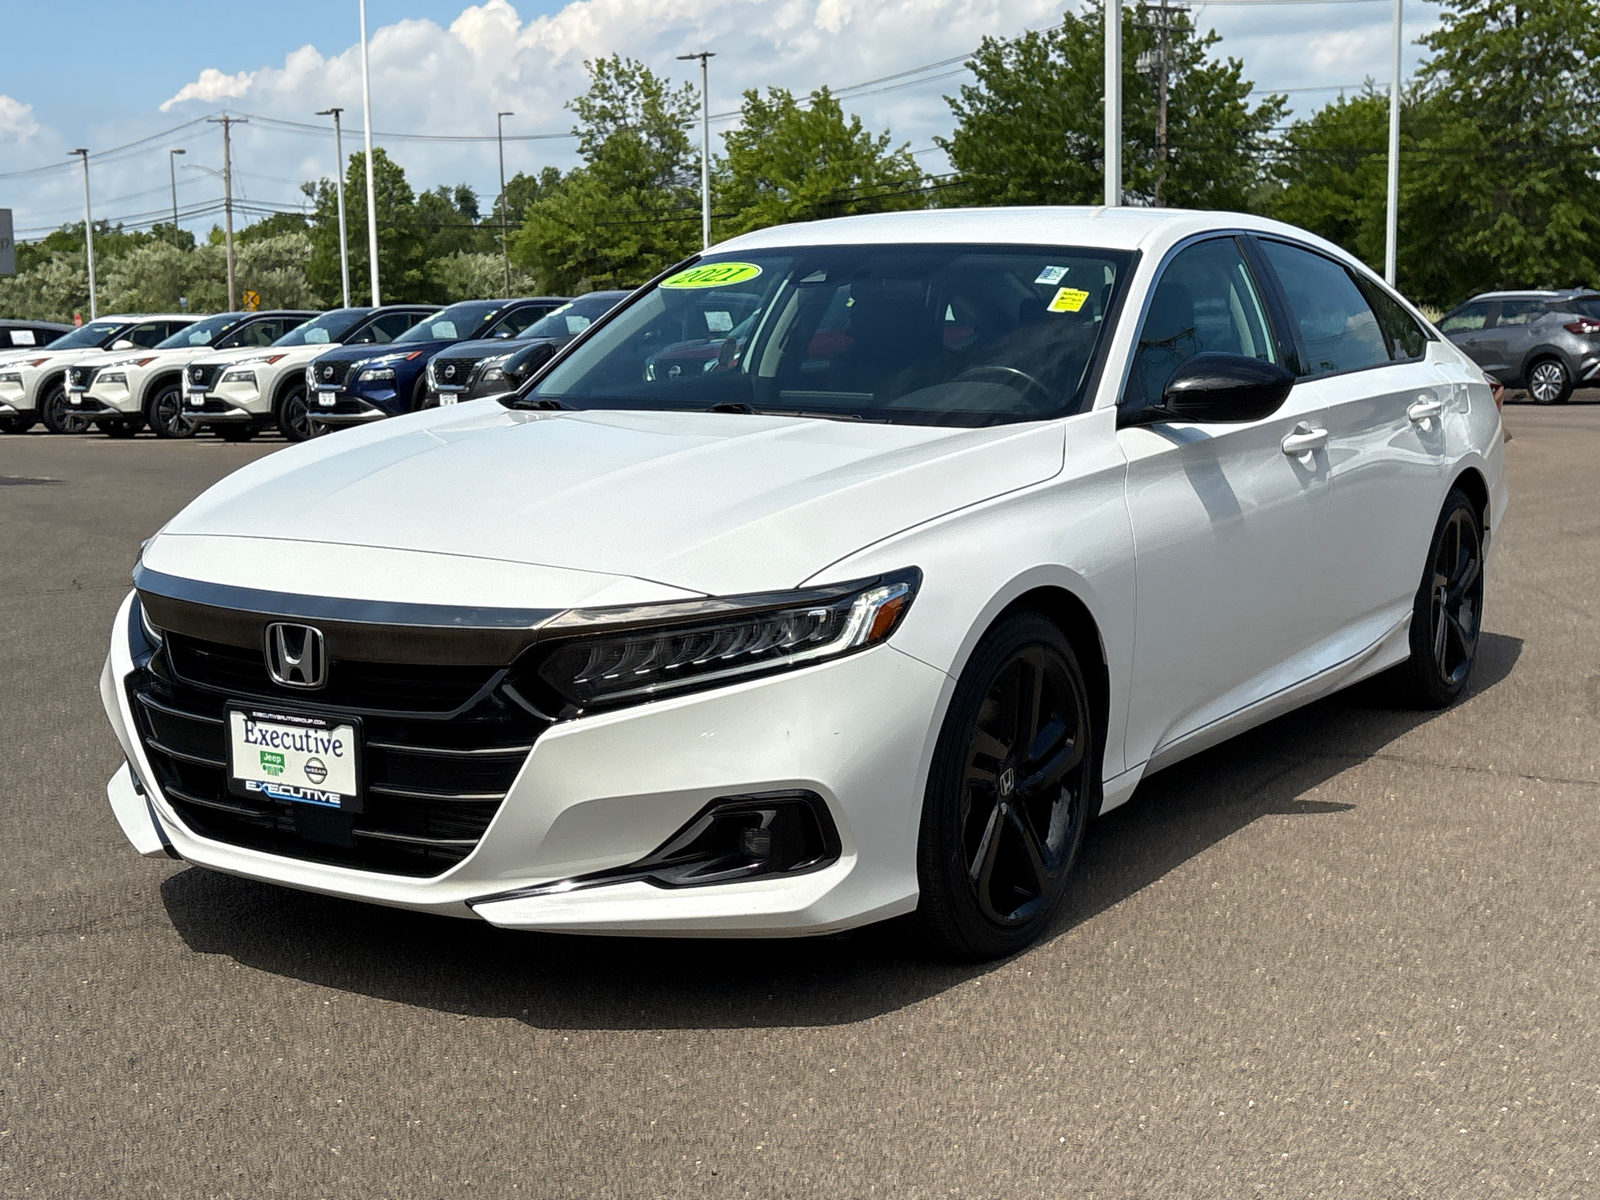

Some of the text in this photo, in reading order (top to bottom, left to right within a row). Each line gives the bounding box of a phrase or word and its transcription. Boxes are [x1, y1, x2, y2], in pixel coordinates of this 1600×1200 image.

[669, 268, 750, 284] 2021
[243, 719, 344, 757] Executive
[263, 753, 282, 764] Jeep
[305, 766, 327, 775] NISSAN
[246, 780, 341, 804] EXECUTIVE
